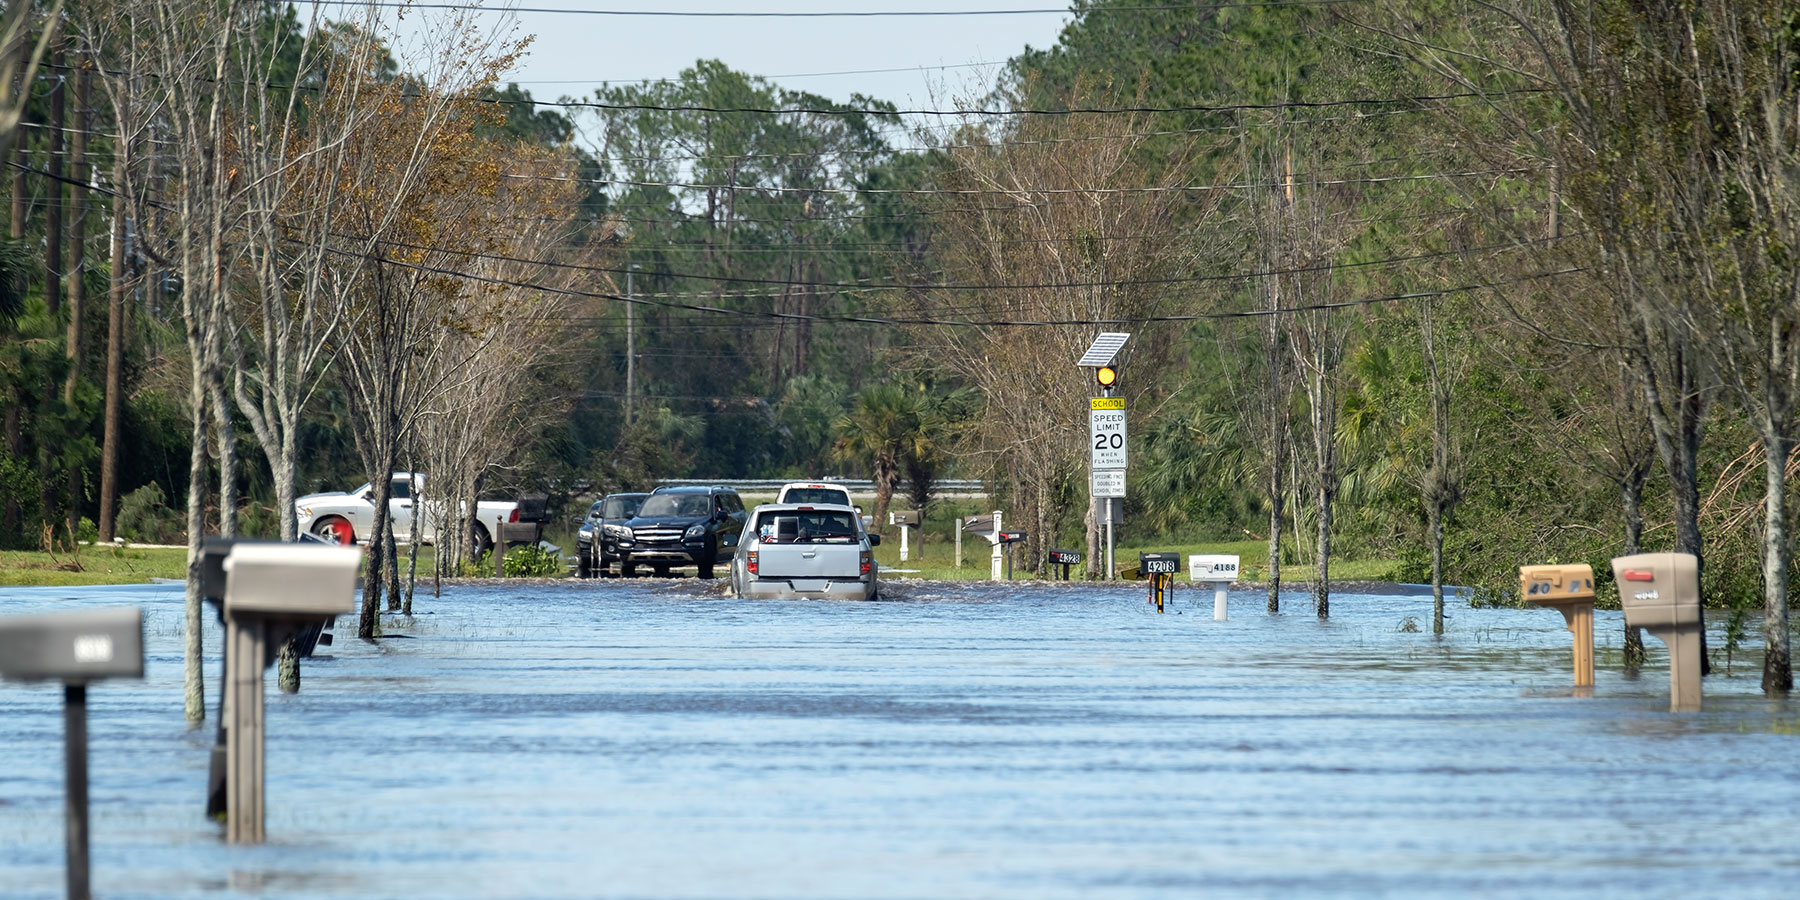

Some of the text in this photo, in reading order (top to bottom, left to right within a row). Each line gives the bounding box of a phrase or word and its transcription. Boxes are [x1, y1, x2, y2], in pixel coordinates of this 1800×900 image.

[1092, 400, 1124, 408] SCHOOL
[1093, 414, 1124, 422] SPEED
[1096, 423, 1120, 431] LIMIT
[1094, 433, 1123, 450] 20
[1148, 561, 1175, 572] 4208
[1213, 563, 1236, 572] 4188
